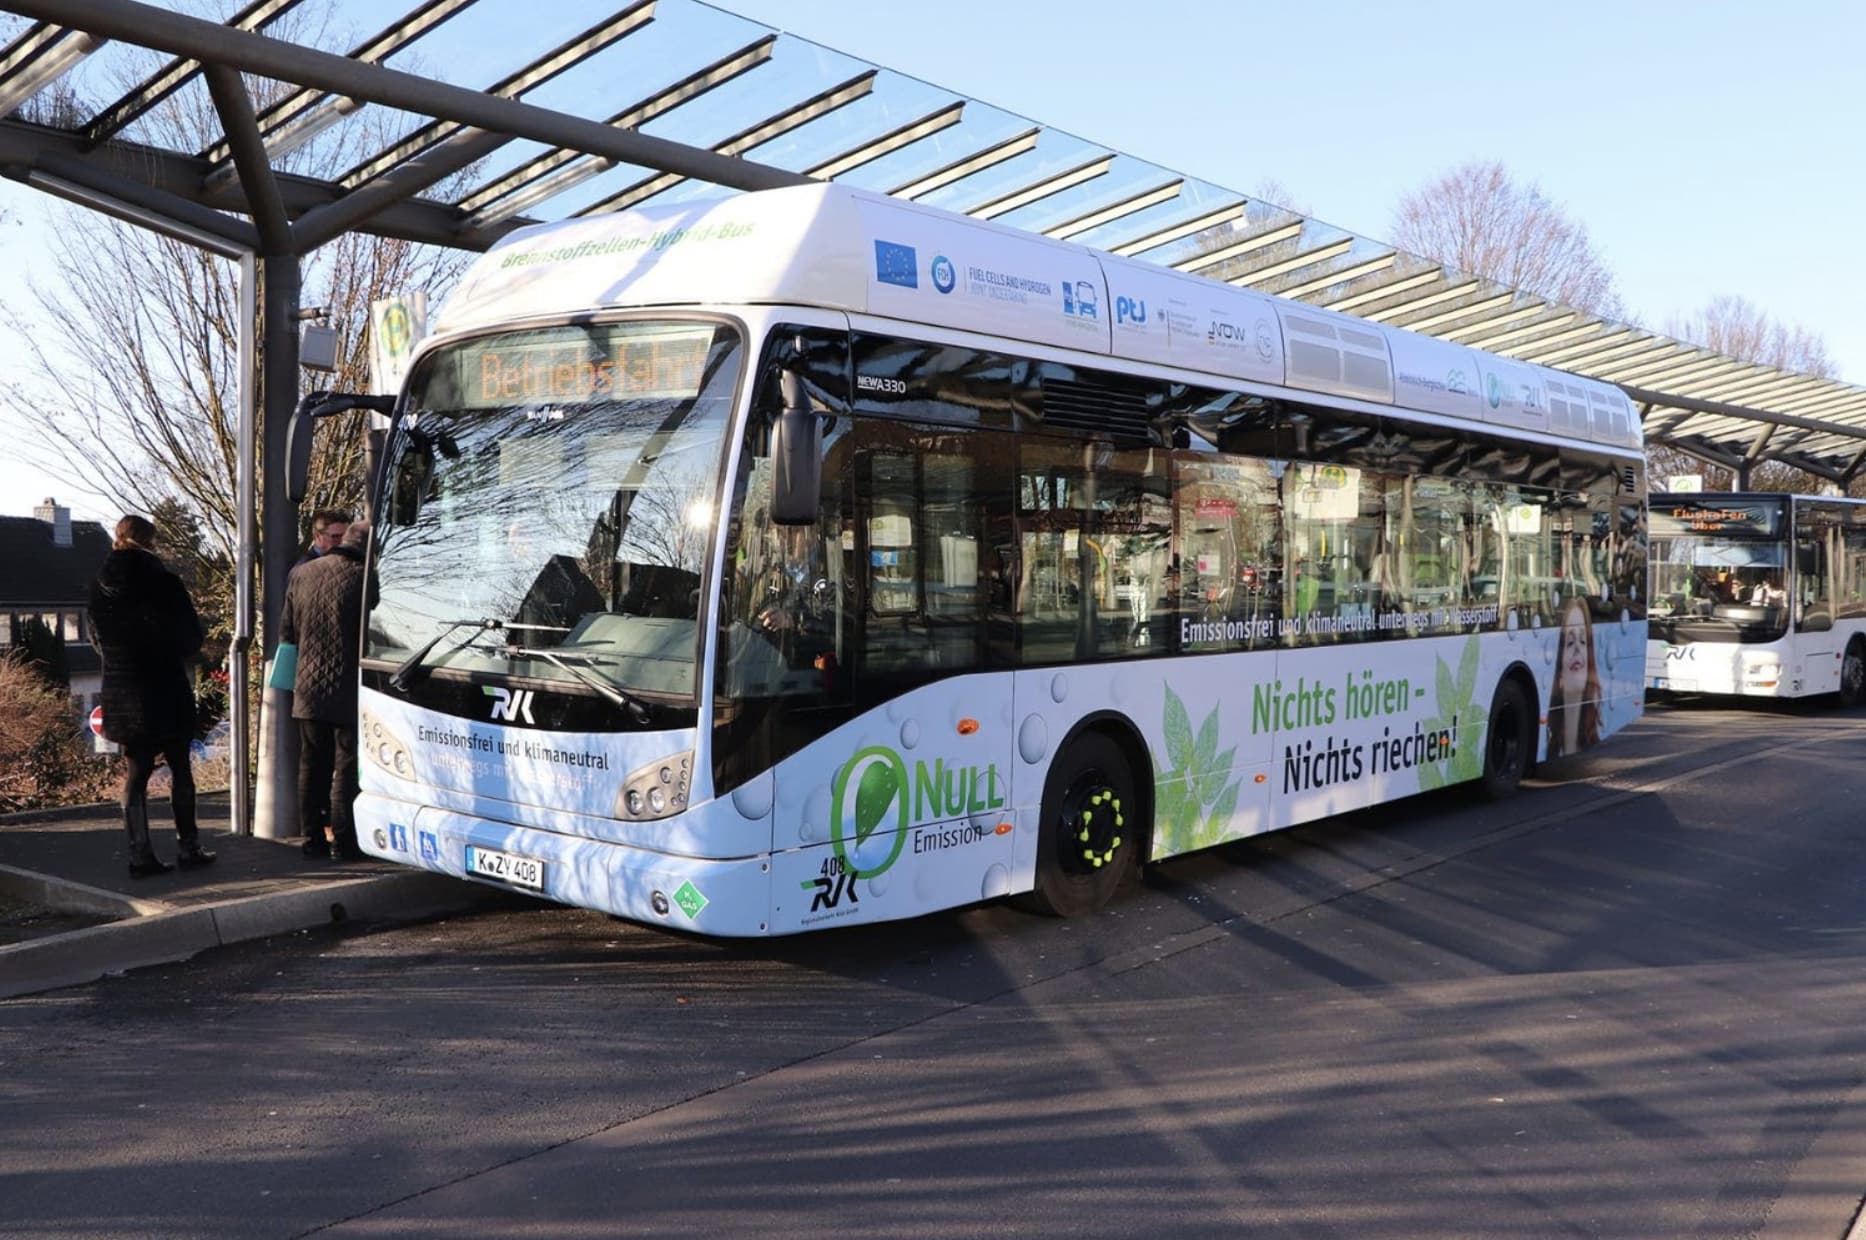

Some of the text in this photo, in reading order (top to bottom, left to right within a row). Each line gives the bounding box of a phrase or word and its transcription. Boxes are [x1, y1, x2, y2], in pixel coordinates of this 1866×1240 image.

[969, 267, 985, 282] FUEL
[985, 270, 1006, 286] CELLS
[481, 342, 704, 401] Betriebsfahrt
[1181, 613, 1274, 643] Emissionsfrei
[1278, 614, 1301, 637] und
[1305, 608, 1376, 636] klimaneutral
[1252, 677, 1336, 736] Nichts
[1346, 670, 1409, 720] hören
[418, 724, 609, 770] Emissionsfrei und klimaneutral
[1284, 716, 1458, 795] Nichts riechen!
[914, 821, 983, 854] Emission
[478, 851, 537, 882] K ZY 408
[820, 854, 845, 877] 408
